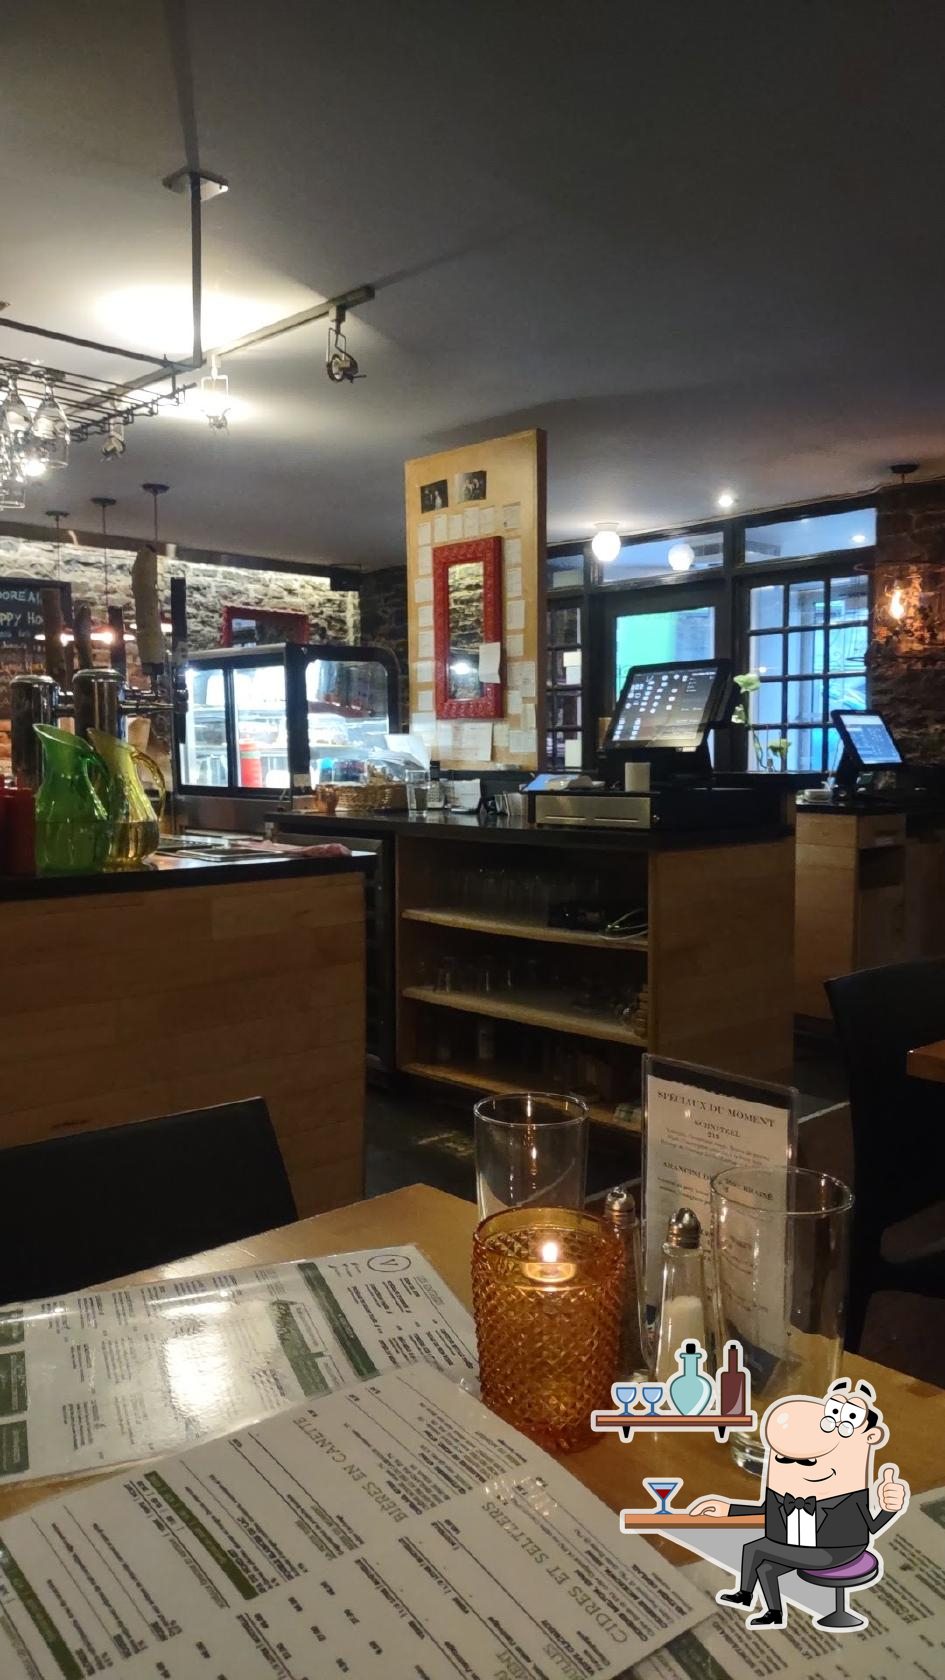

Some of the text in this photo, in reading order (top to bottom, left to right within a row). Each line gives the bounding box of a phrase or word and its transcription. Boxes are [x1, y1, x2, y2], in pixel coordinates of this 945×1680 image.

[708, 1103, 725, 1115] DU
[727, 1108, 776, 1128] MOMENT
[290, 1413, 348, 1465] CANETTE
[341, 1460, 367, 1484] EN
[357, 1480, 409, 1525] BIÈRES
[479, 1499, 549, 1564] SELTZERS
[544, 1562, 570, 1585] ET
[565, 1583, 631, 1646] CIDRES
